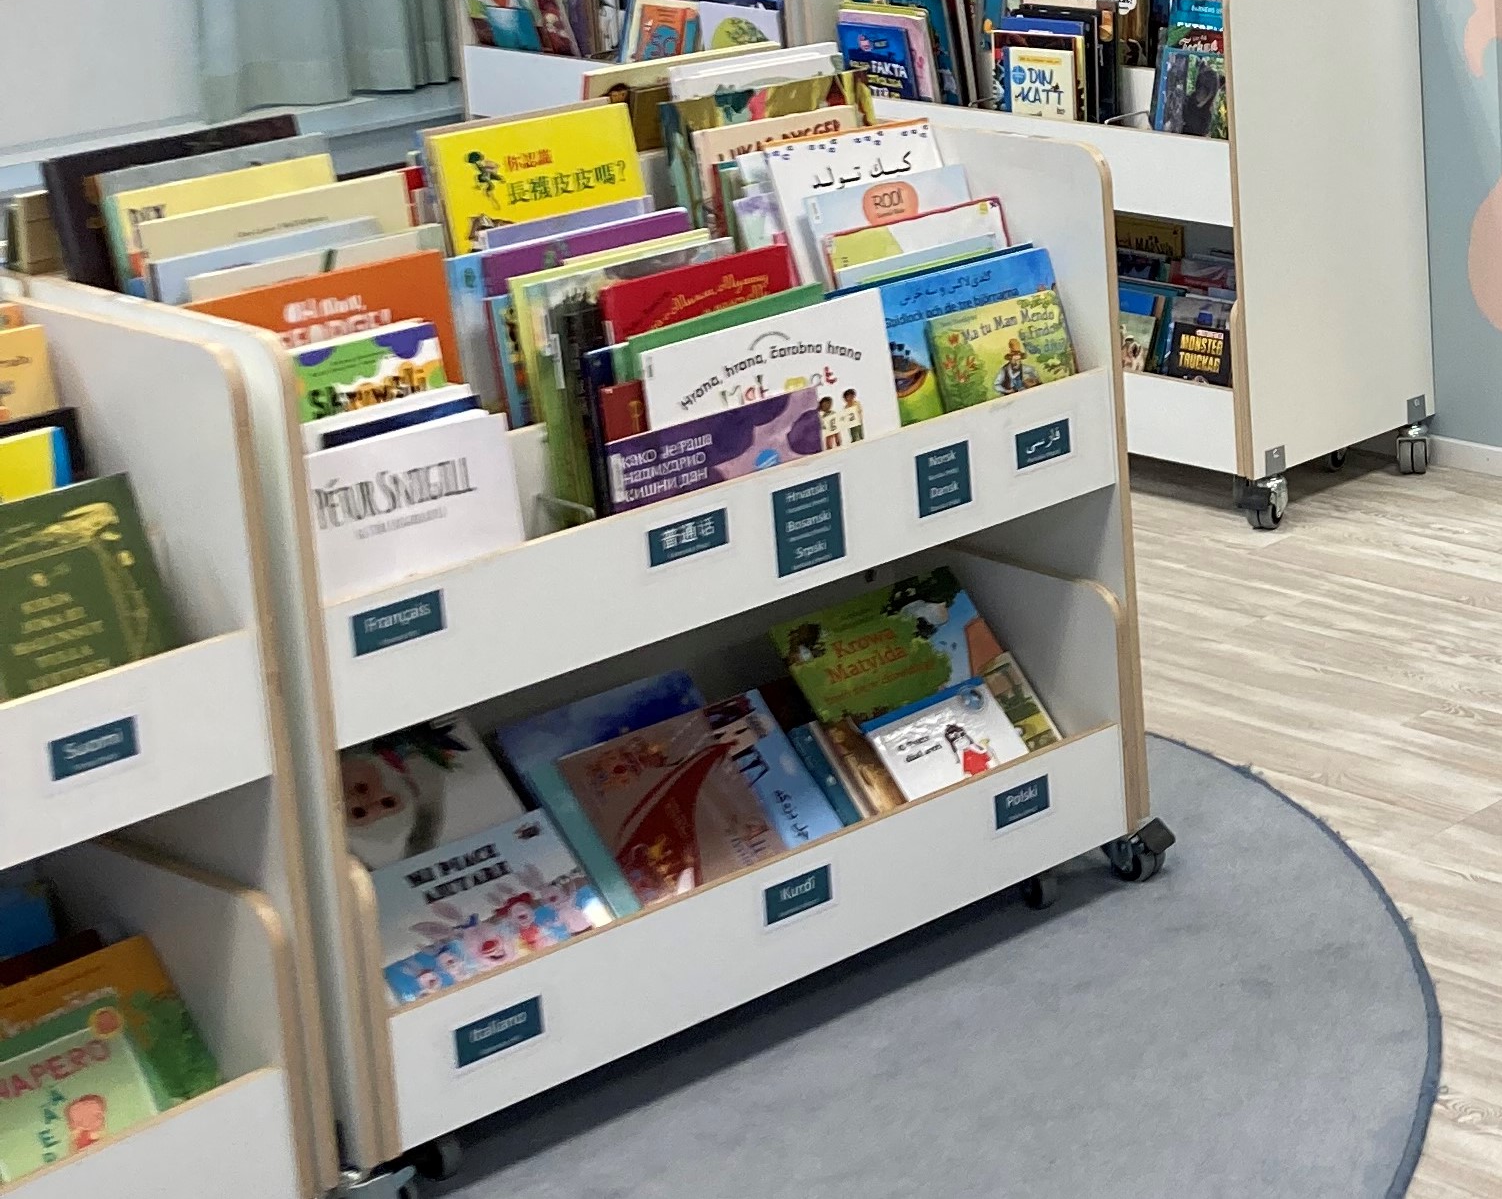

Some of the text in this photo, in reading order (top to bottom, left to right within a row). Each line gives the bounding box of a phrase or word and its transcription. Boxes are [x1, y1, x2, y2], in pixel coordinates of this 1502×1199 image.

[871, 60, 908, 79] FAKTA
[1027, 67, 1054, 86] DIN
[1015, 86, 1064, 105] KATT
[680, 375, 724, 411] Hrana,
[723, 354, 768, 378] hrana,
[827, 340, 863, 361] hrana
[785, 508, 832, 533] Bosanski
[364, 603, 432, 635] Français
[1005, 783, 1039, 810] Polski
